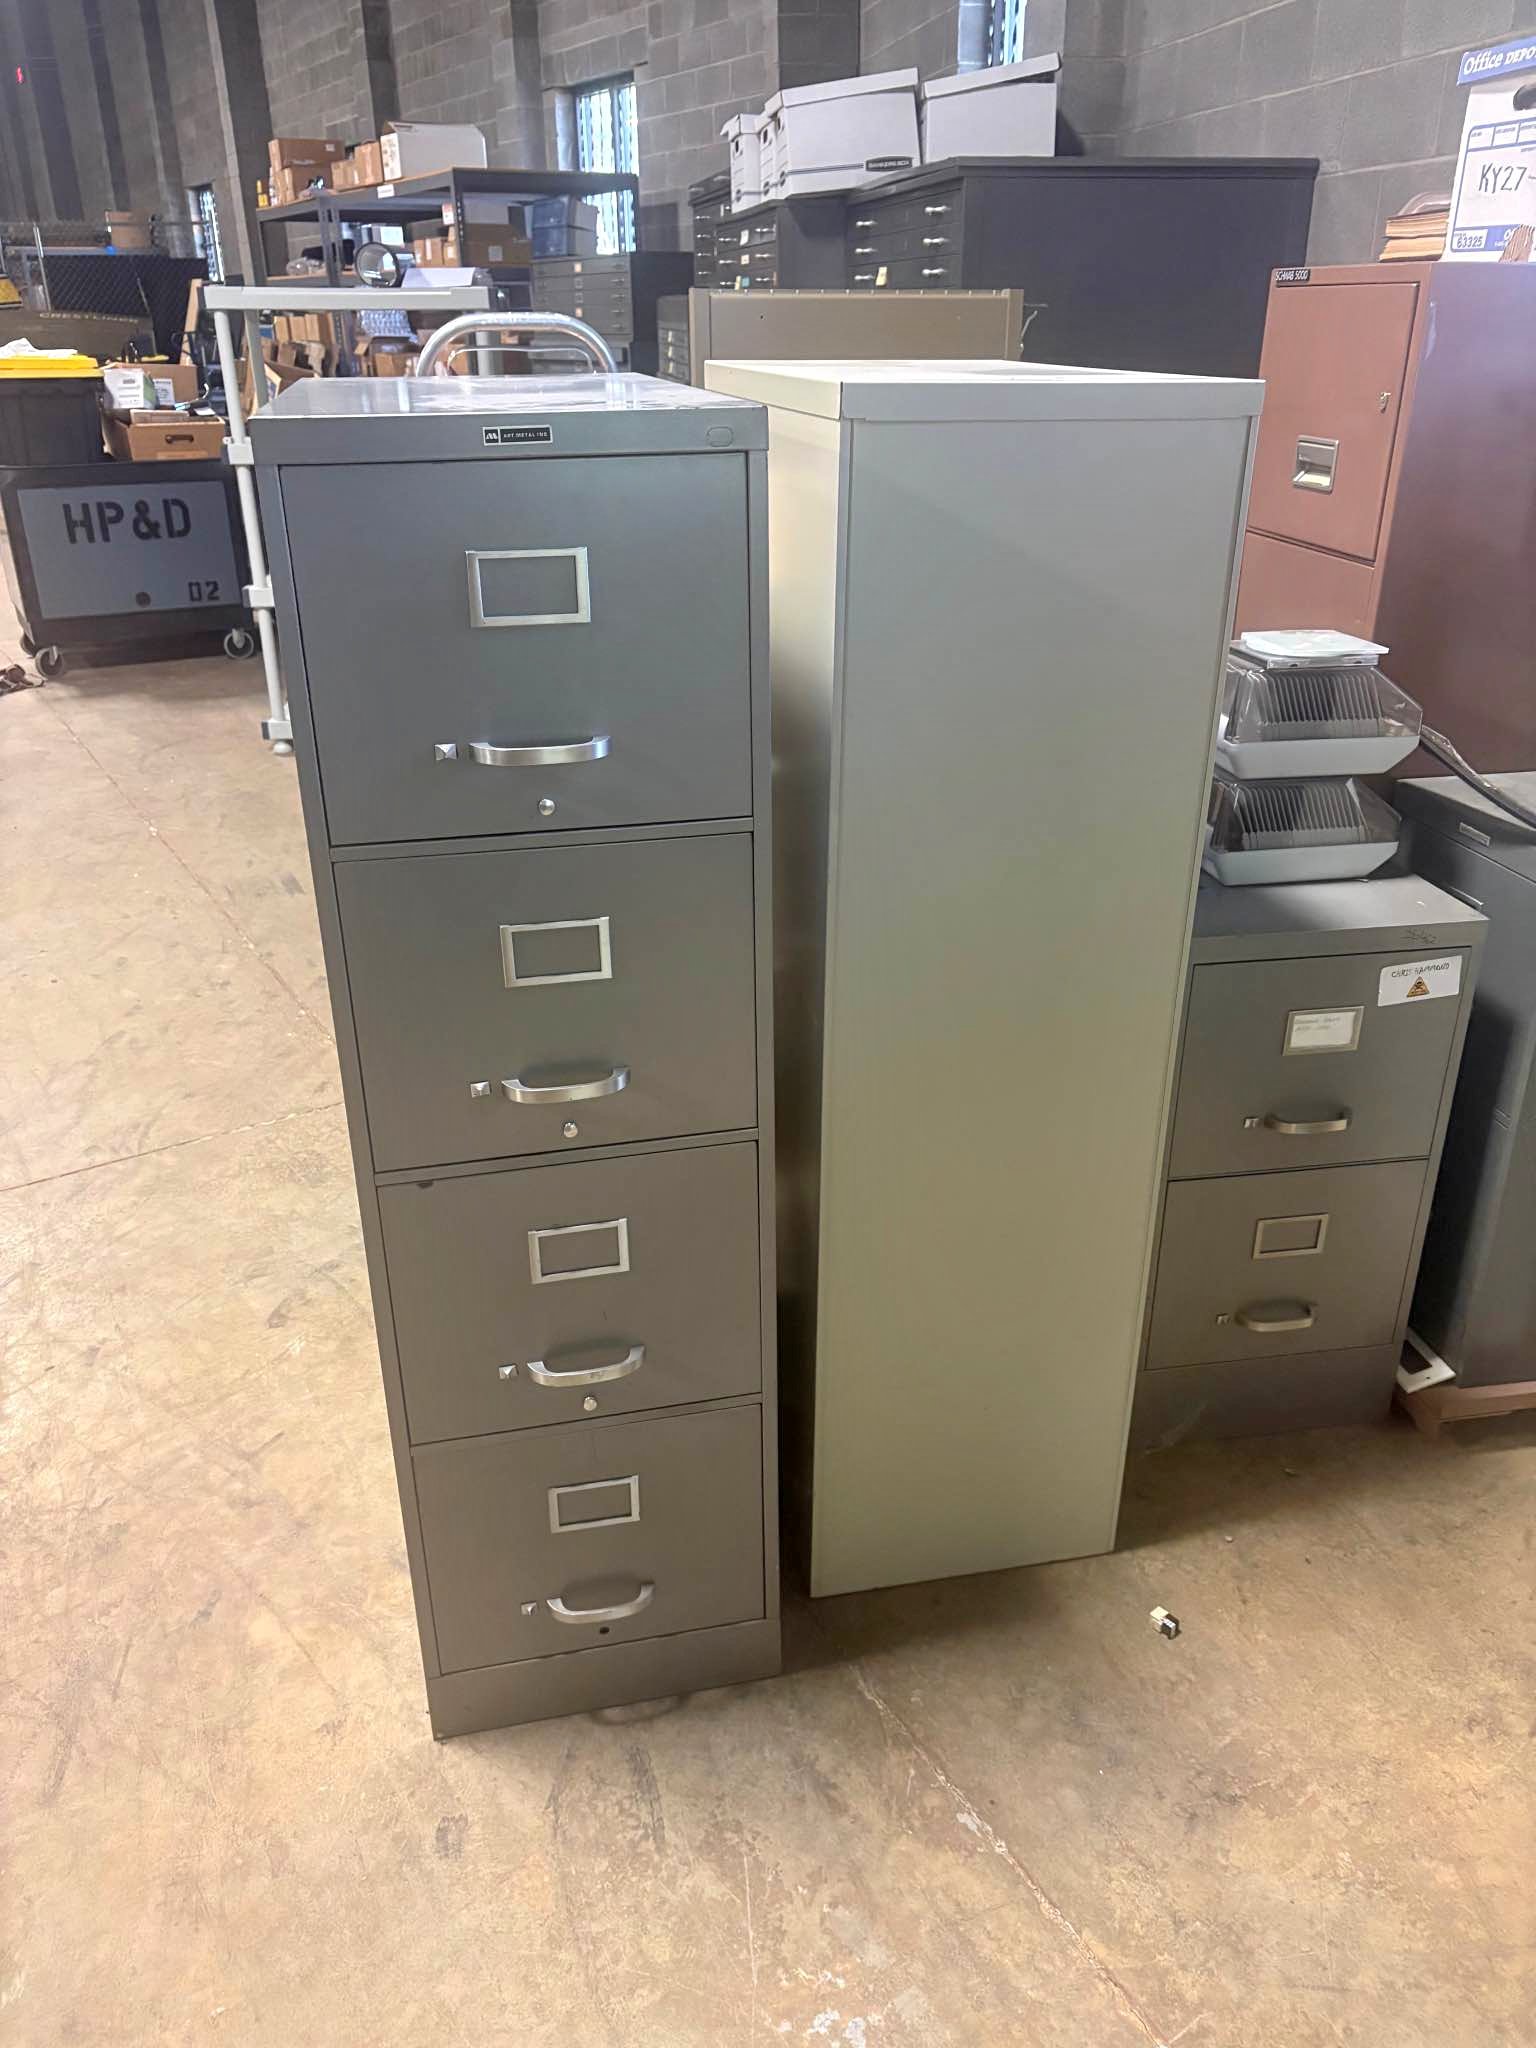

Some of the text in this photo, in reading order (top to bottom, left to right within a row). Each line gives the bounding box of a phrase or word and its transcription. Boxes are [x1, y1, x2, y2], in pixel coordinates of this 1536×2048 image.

[1463, 46, 1536, 75] Office DEPO
[62, 498, 191, 544] HP&D
